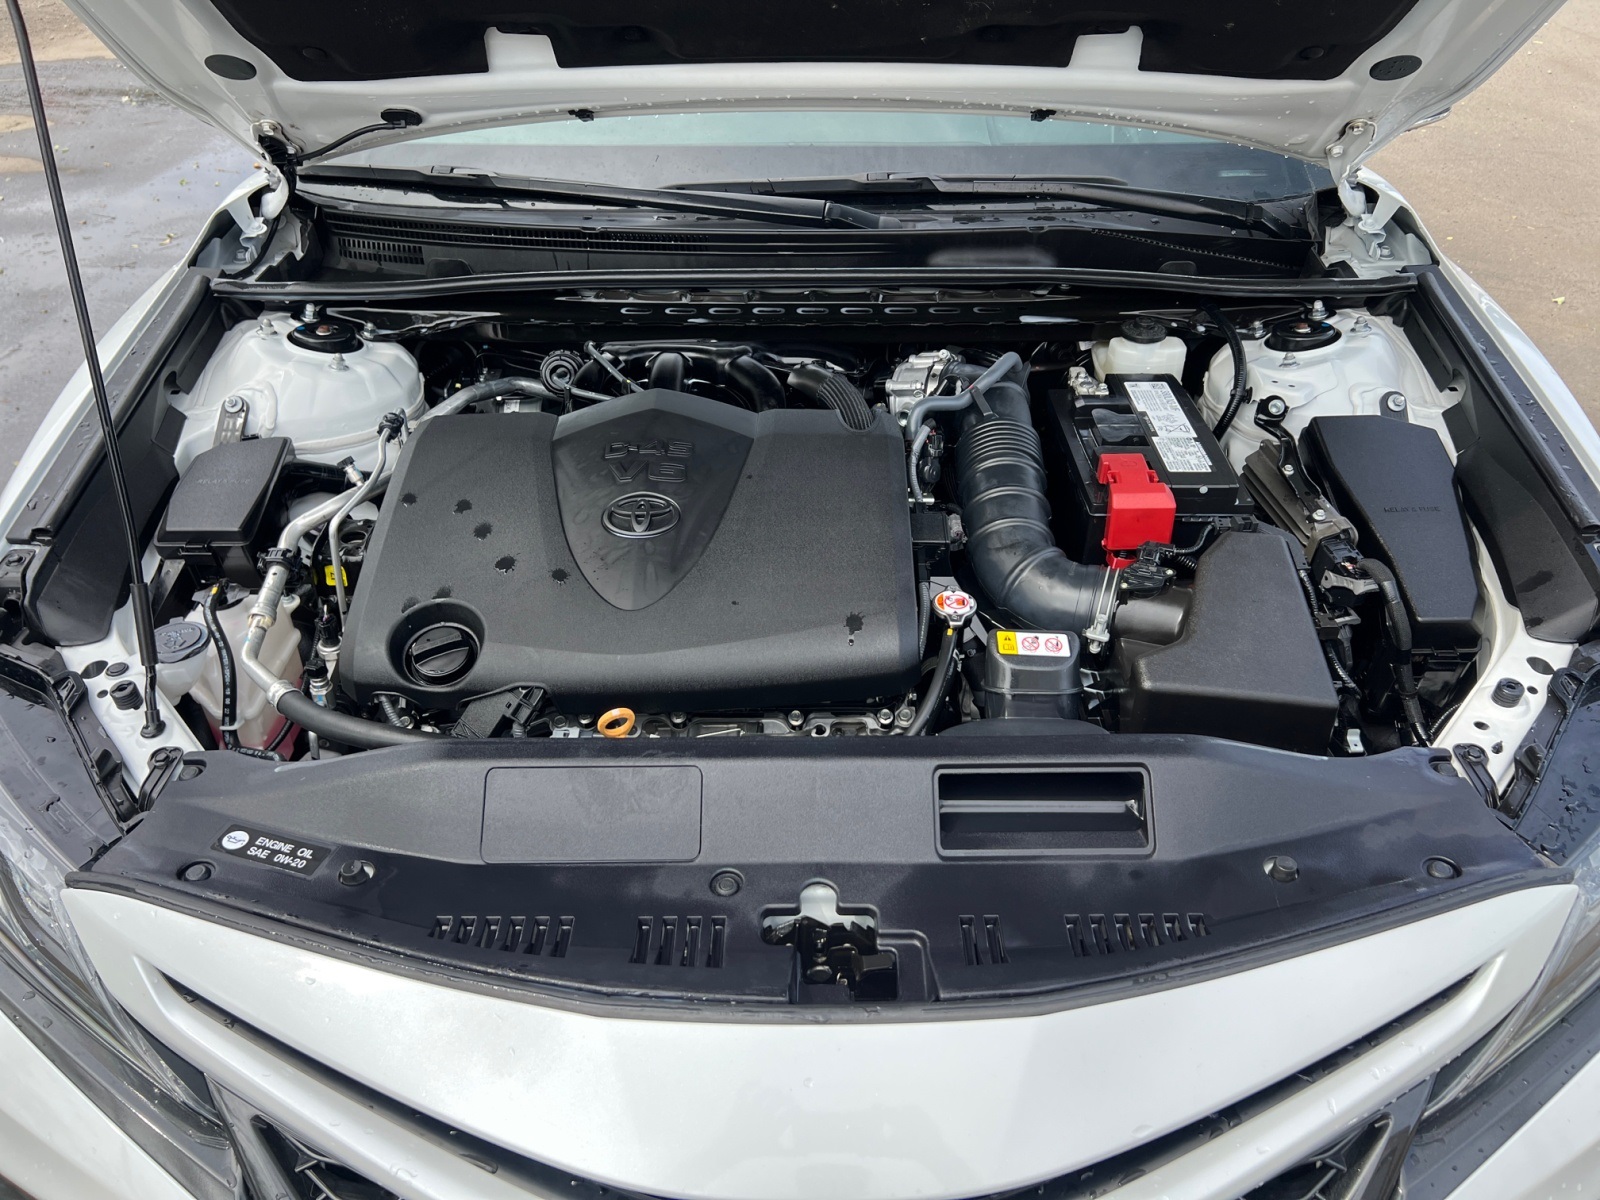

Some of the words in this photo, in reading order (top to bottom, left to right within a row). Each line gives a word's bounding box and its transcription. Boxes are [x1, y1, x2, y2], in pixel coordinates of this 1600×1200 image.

[608, 461, 687, 483] V6
[246, 846, 271, 859] SAE
[273, 853, 307, 869] 0W-20
[255, 836, 295, 853] ENGINE
[296, 847, 314, 859] OIL
